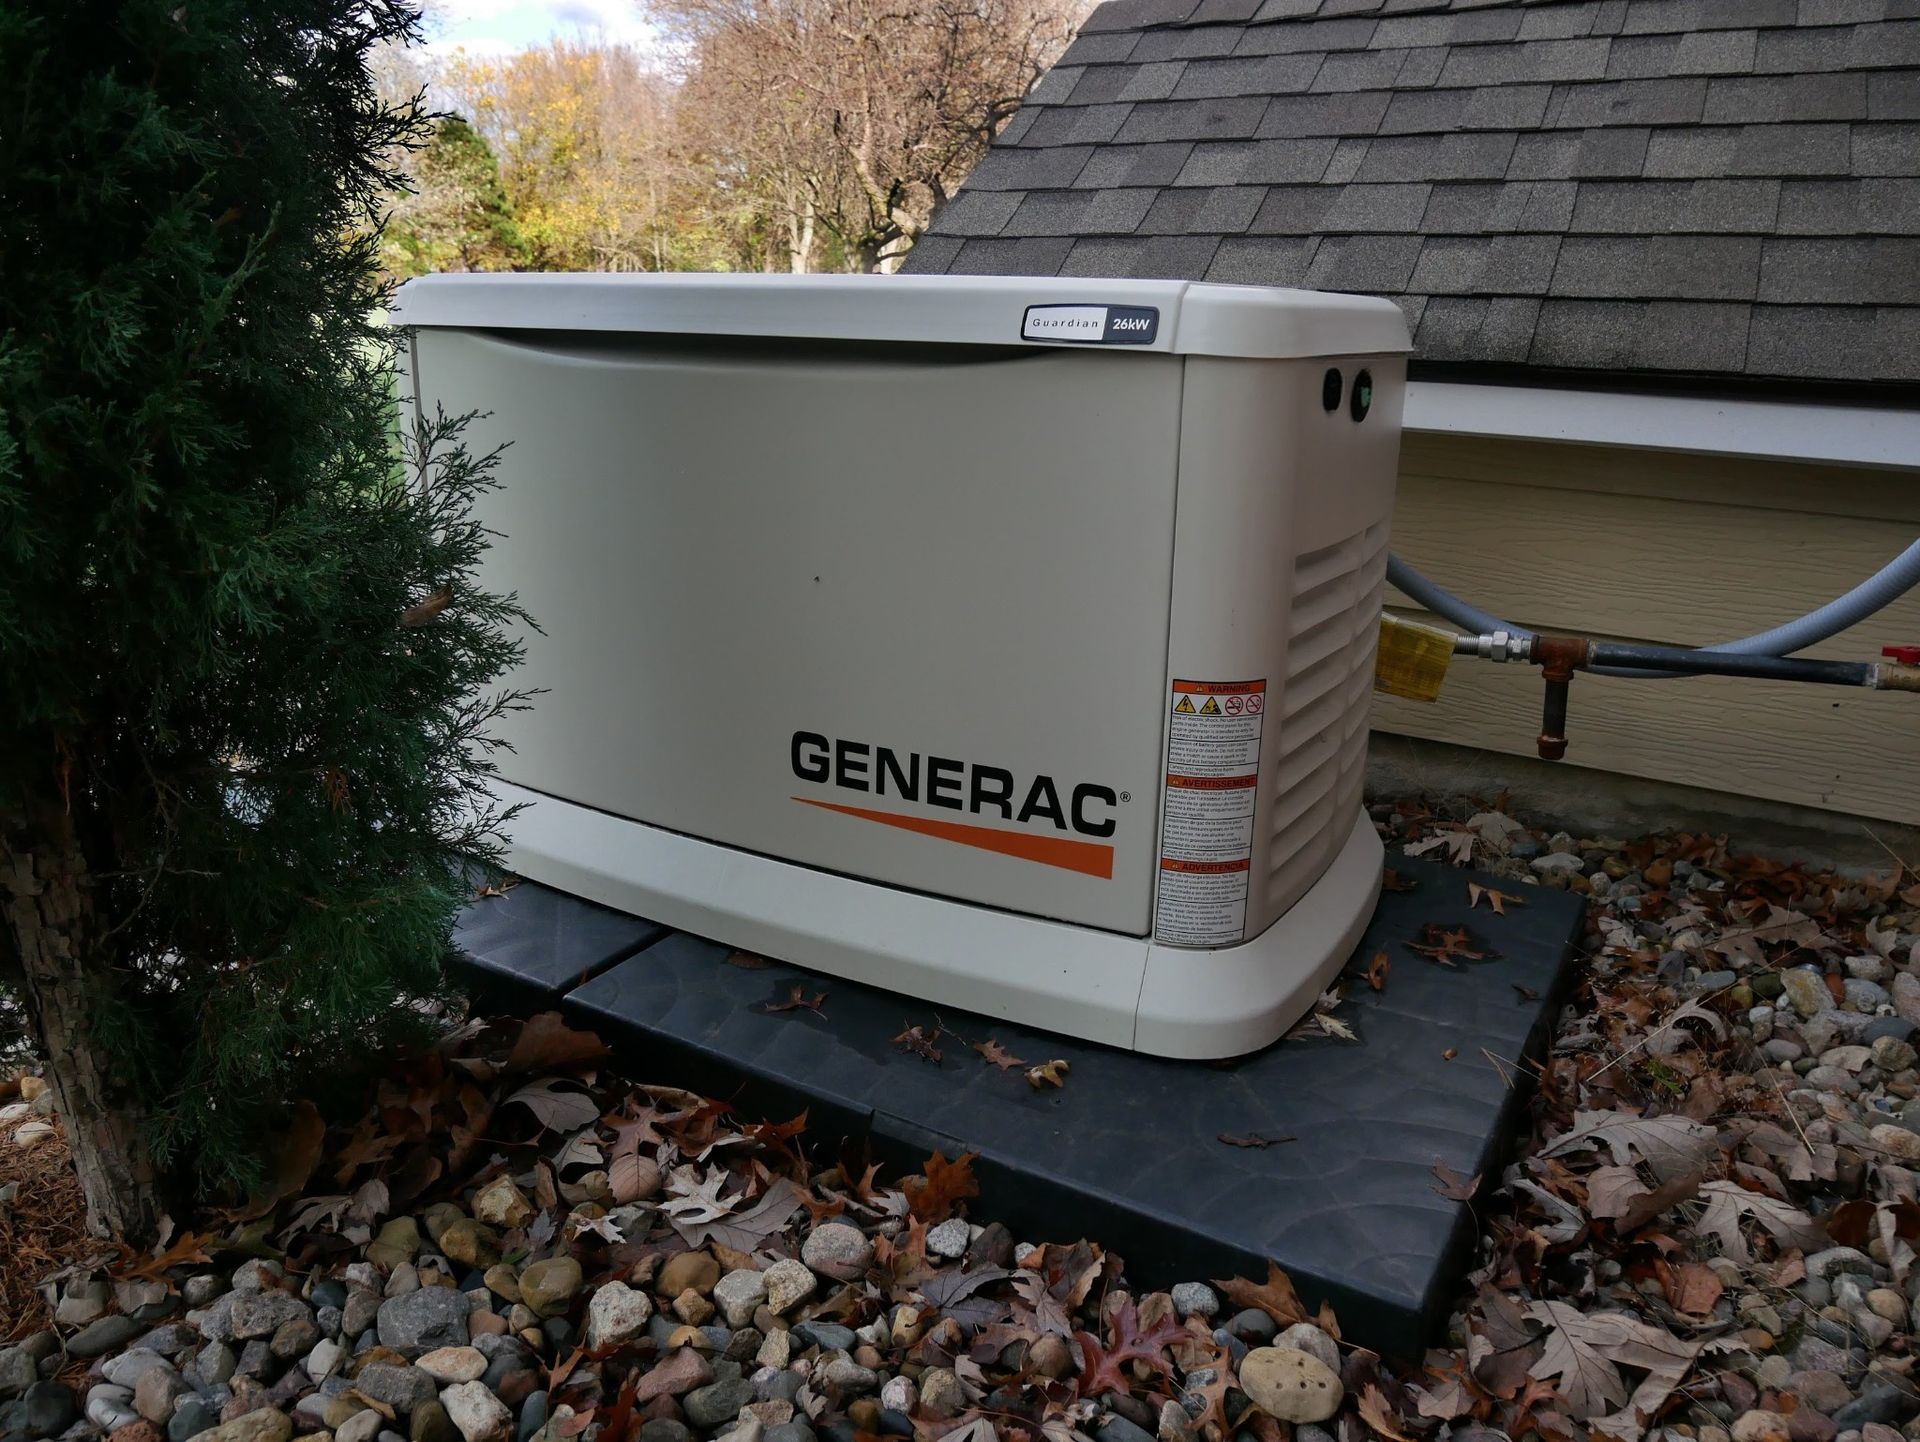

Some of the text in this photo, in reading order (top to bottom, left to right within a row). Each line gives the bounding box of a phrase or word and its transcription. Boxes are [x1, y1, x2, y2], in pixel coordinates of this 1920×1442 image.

[1032, 318, 1150, 331] Guardian 26kW
[1207, 684, 1251, 694] WARNING
[1182, 777, 1256, 788] AVERTISSEMENT
[1182, 862, 1244, 872] ADVERTENCIA
